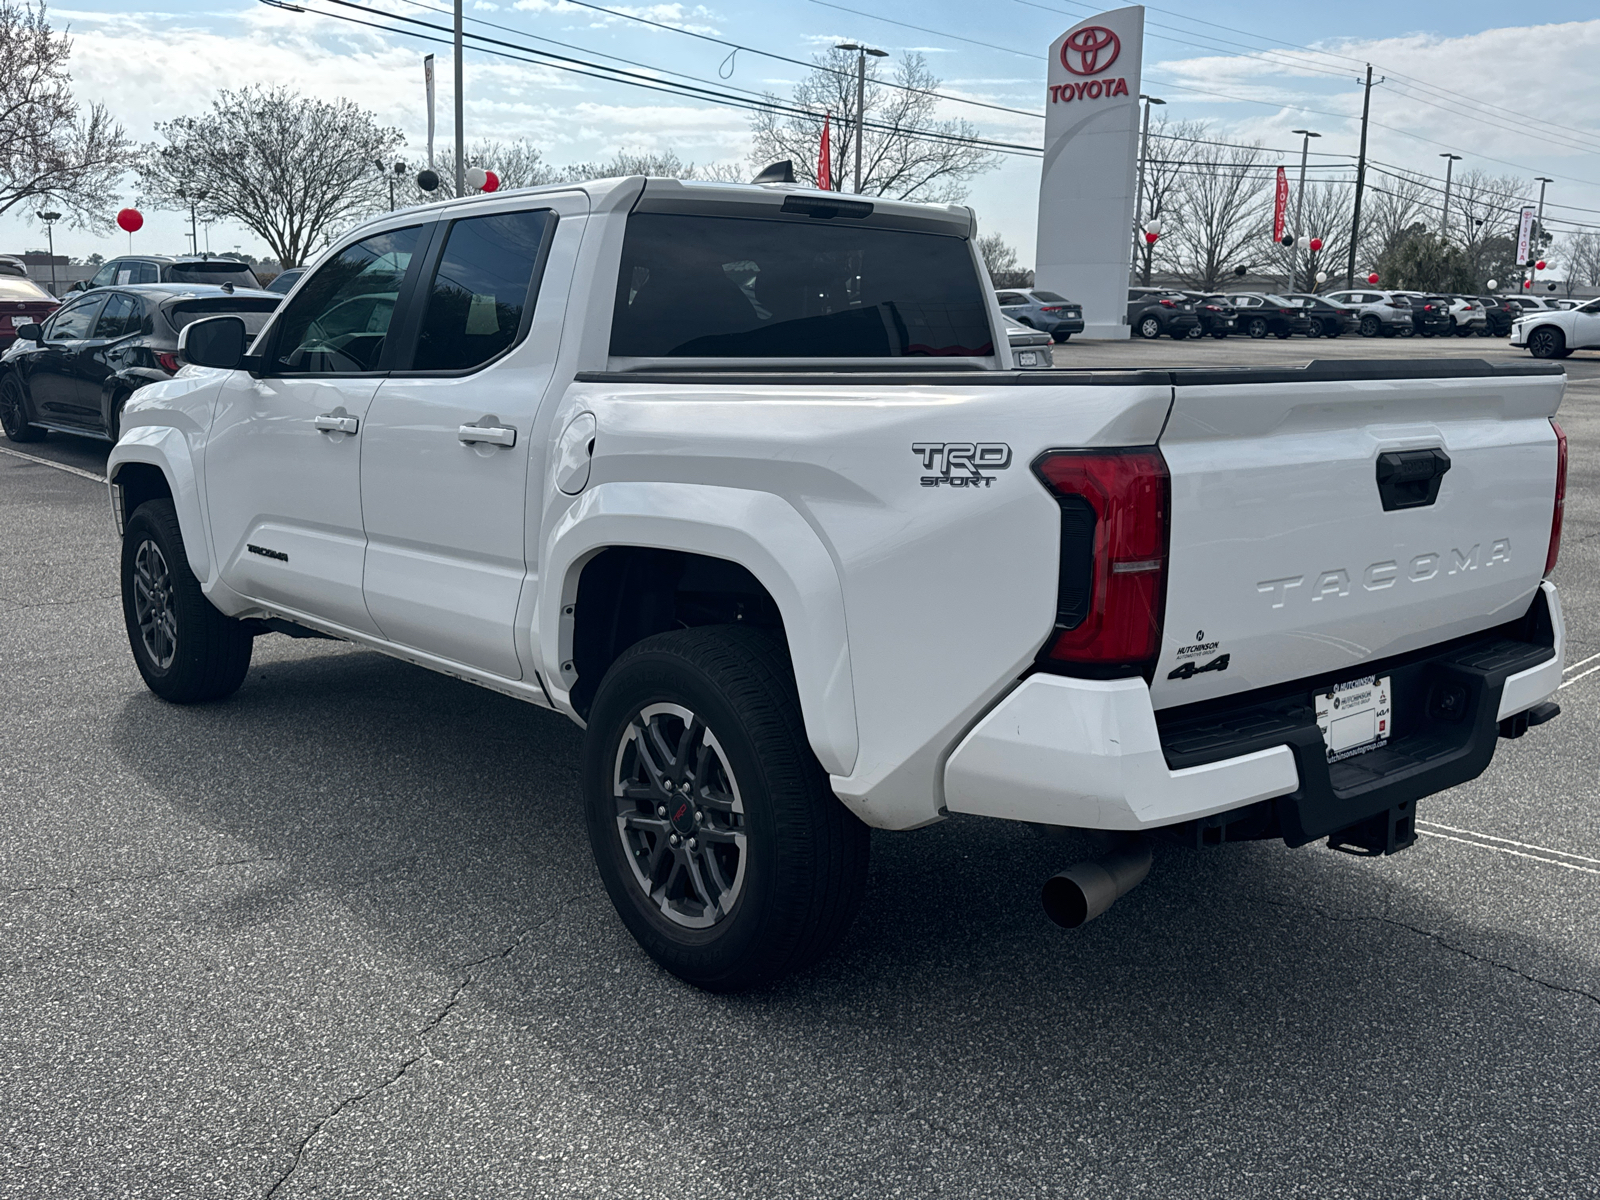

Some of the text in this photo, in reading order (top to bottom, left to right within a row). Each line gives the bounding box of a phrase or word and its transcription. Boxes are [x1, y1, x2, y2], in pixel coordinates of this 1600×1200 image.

[1049, 78, 1129, 103] TOYOTA
[911, 442, 1013, 477] TRD
[919, 475, 997, 488] SPORT
[1257, 537, 1512, 609] TACOMA
[1176, 641, 1220, 655] HUTCHINSON
[1339, 674, 1376, 692] HUTCHINSON
[1341, 690, 1372, 705] HUTCHINSON
[1327, 740, 1388, 764] utchinsonautogroup.com
[672, 803, 688, 823] TRD
